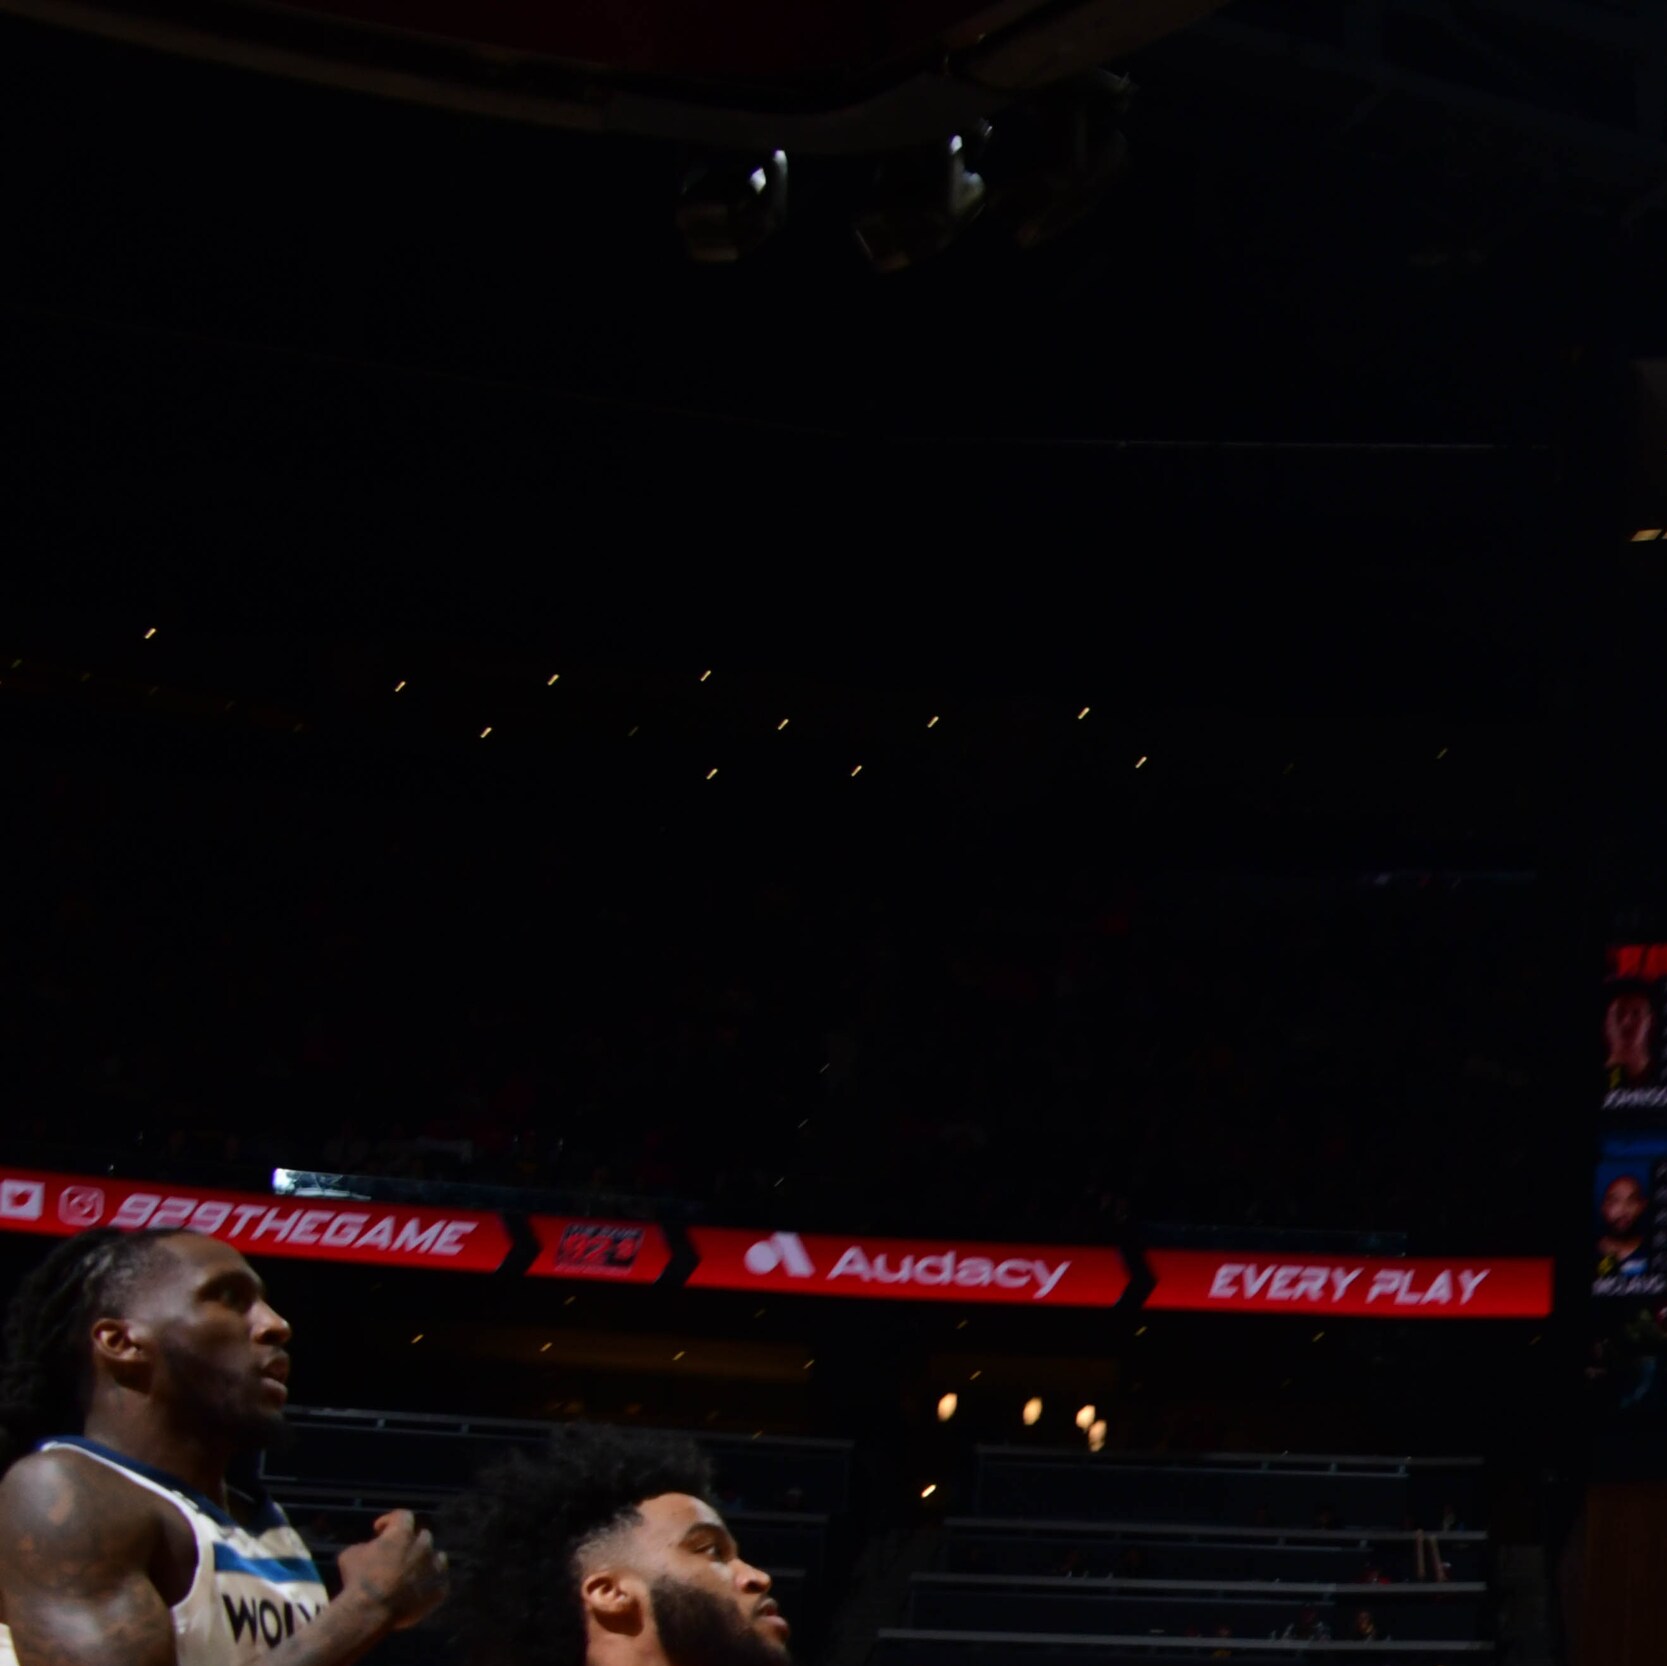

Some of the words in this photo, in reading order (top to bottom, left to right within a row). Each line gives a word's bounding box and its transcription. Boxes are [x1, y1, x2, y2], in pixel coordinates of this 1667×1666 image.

[109, 1192, 479, 1256] 929THEGAME
[827, 1245, 1071, 1299] Audacy
[1208, 1263, 1362, 1304] EVERY
[1365, 1267, 1491, 1307] PLAY
